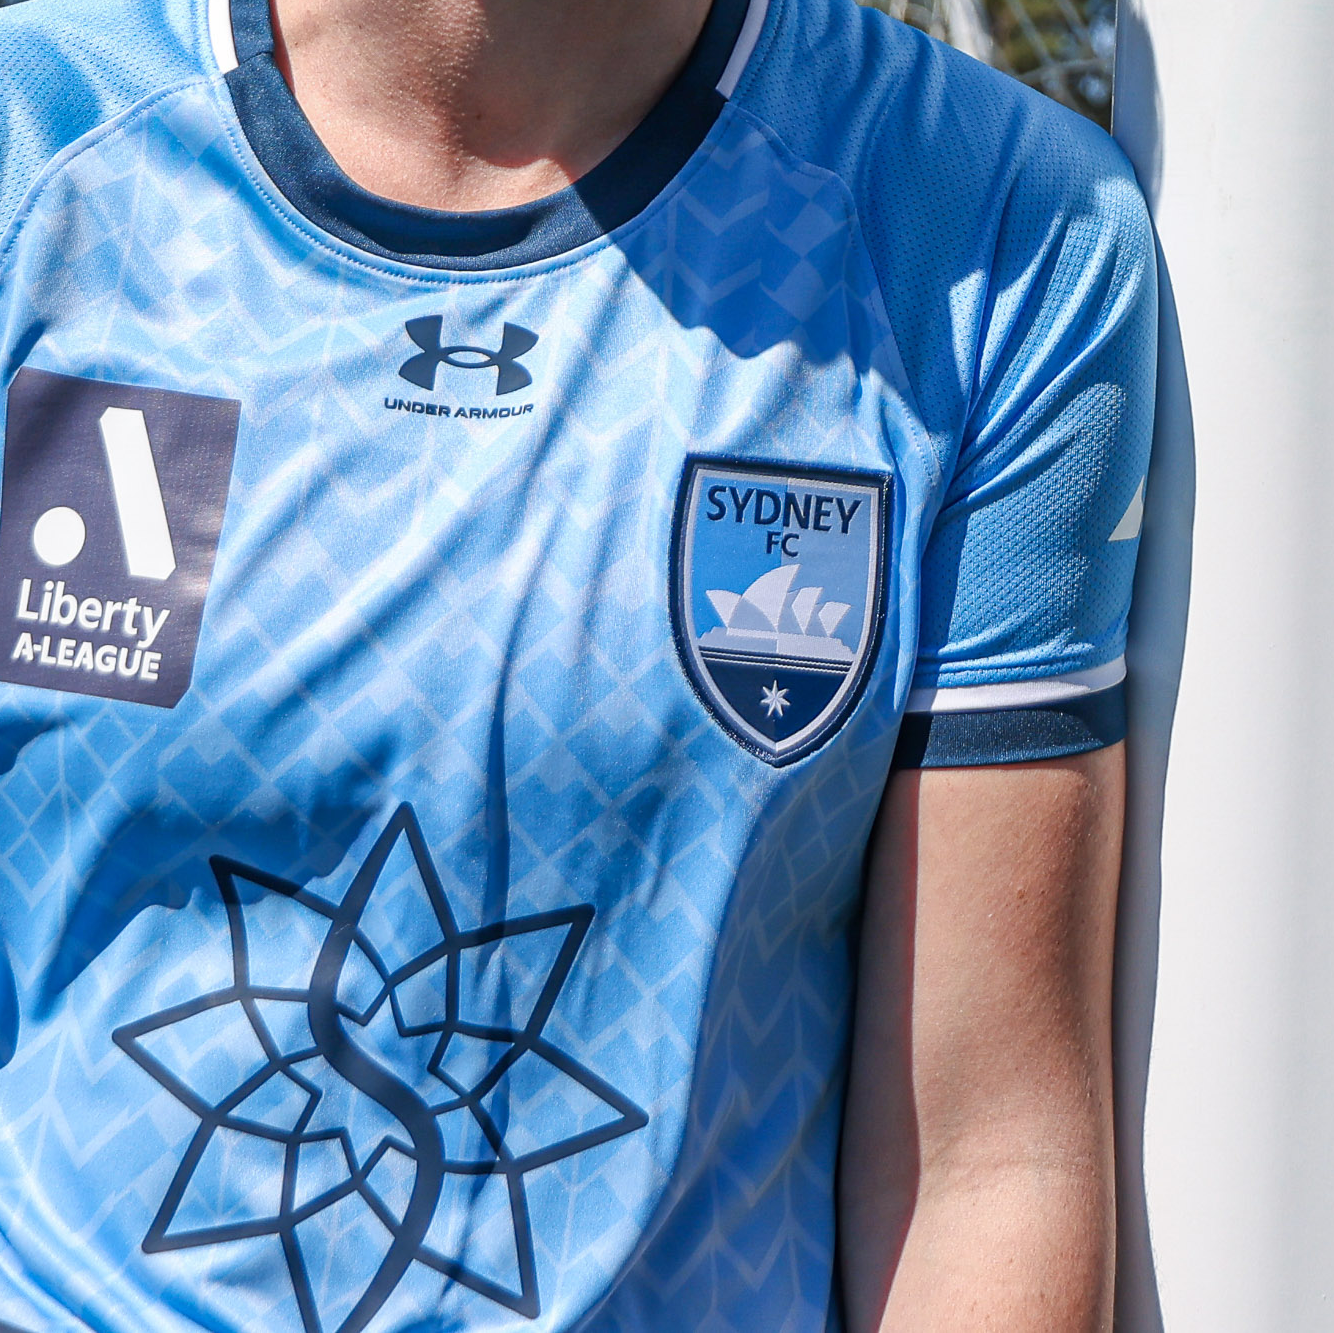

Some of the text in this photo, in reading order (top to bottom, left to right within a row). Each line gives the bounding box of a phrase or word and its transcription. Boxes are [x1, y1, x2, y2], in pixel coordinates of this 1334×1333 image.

[384, 397, 534, 419] UNDER ARMOUR
[706, 484, 862, 535] SYDNEY
[766, 530, 800, 558] FC
[17, 578, 171, 648] Liberty
[12, 632, 163, 681] A-LEAGUE
